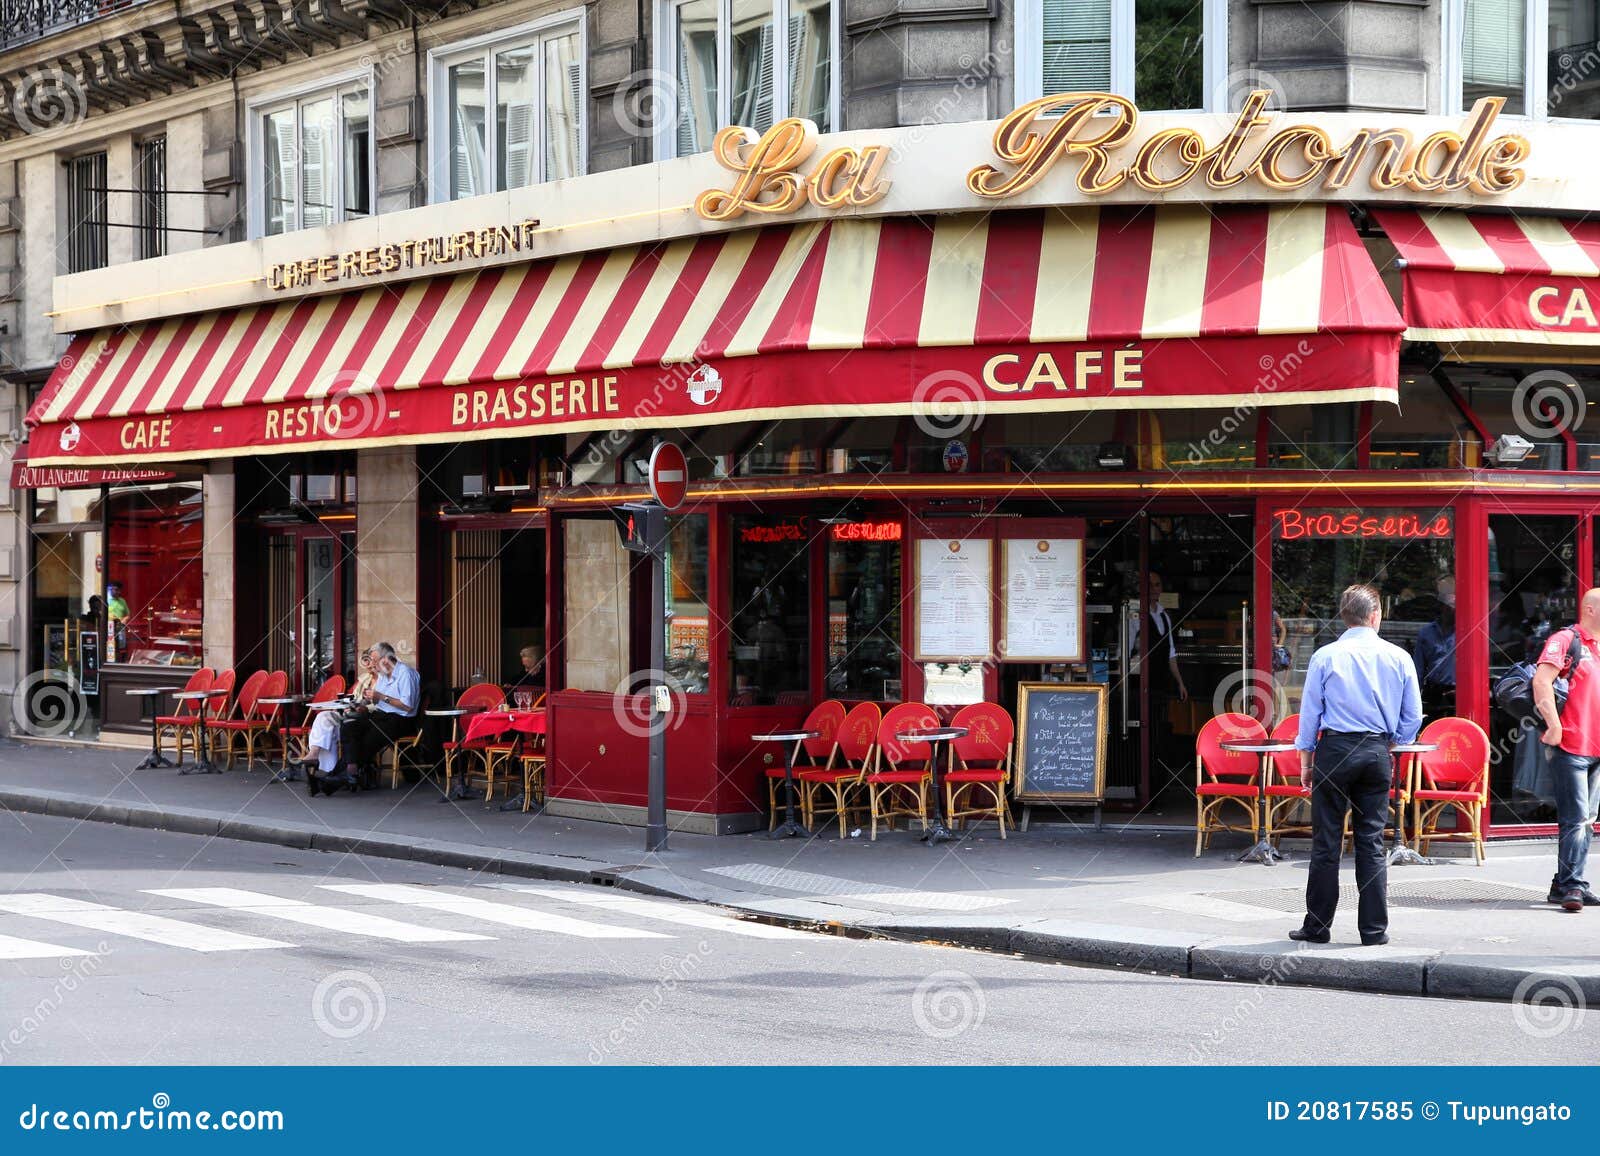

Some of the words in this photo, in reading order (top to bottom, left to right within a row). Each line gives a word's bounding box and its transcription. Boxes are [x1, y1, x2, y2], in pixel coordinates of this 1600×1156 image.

[694, 117, 892, 221] La
[966, 89, 1531, 198] Rotonde
[981, 342, 1145, 393] CAFÉ
[120, 415, 172, 450] CAFÉ
[265, 404, 343, 440] RESTO
[452, 376, 620, 426] BRASSERIE
[18, 468, 90, 487] BOULANGERIE
[1273, 508, 1454, 540] Brasserie
